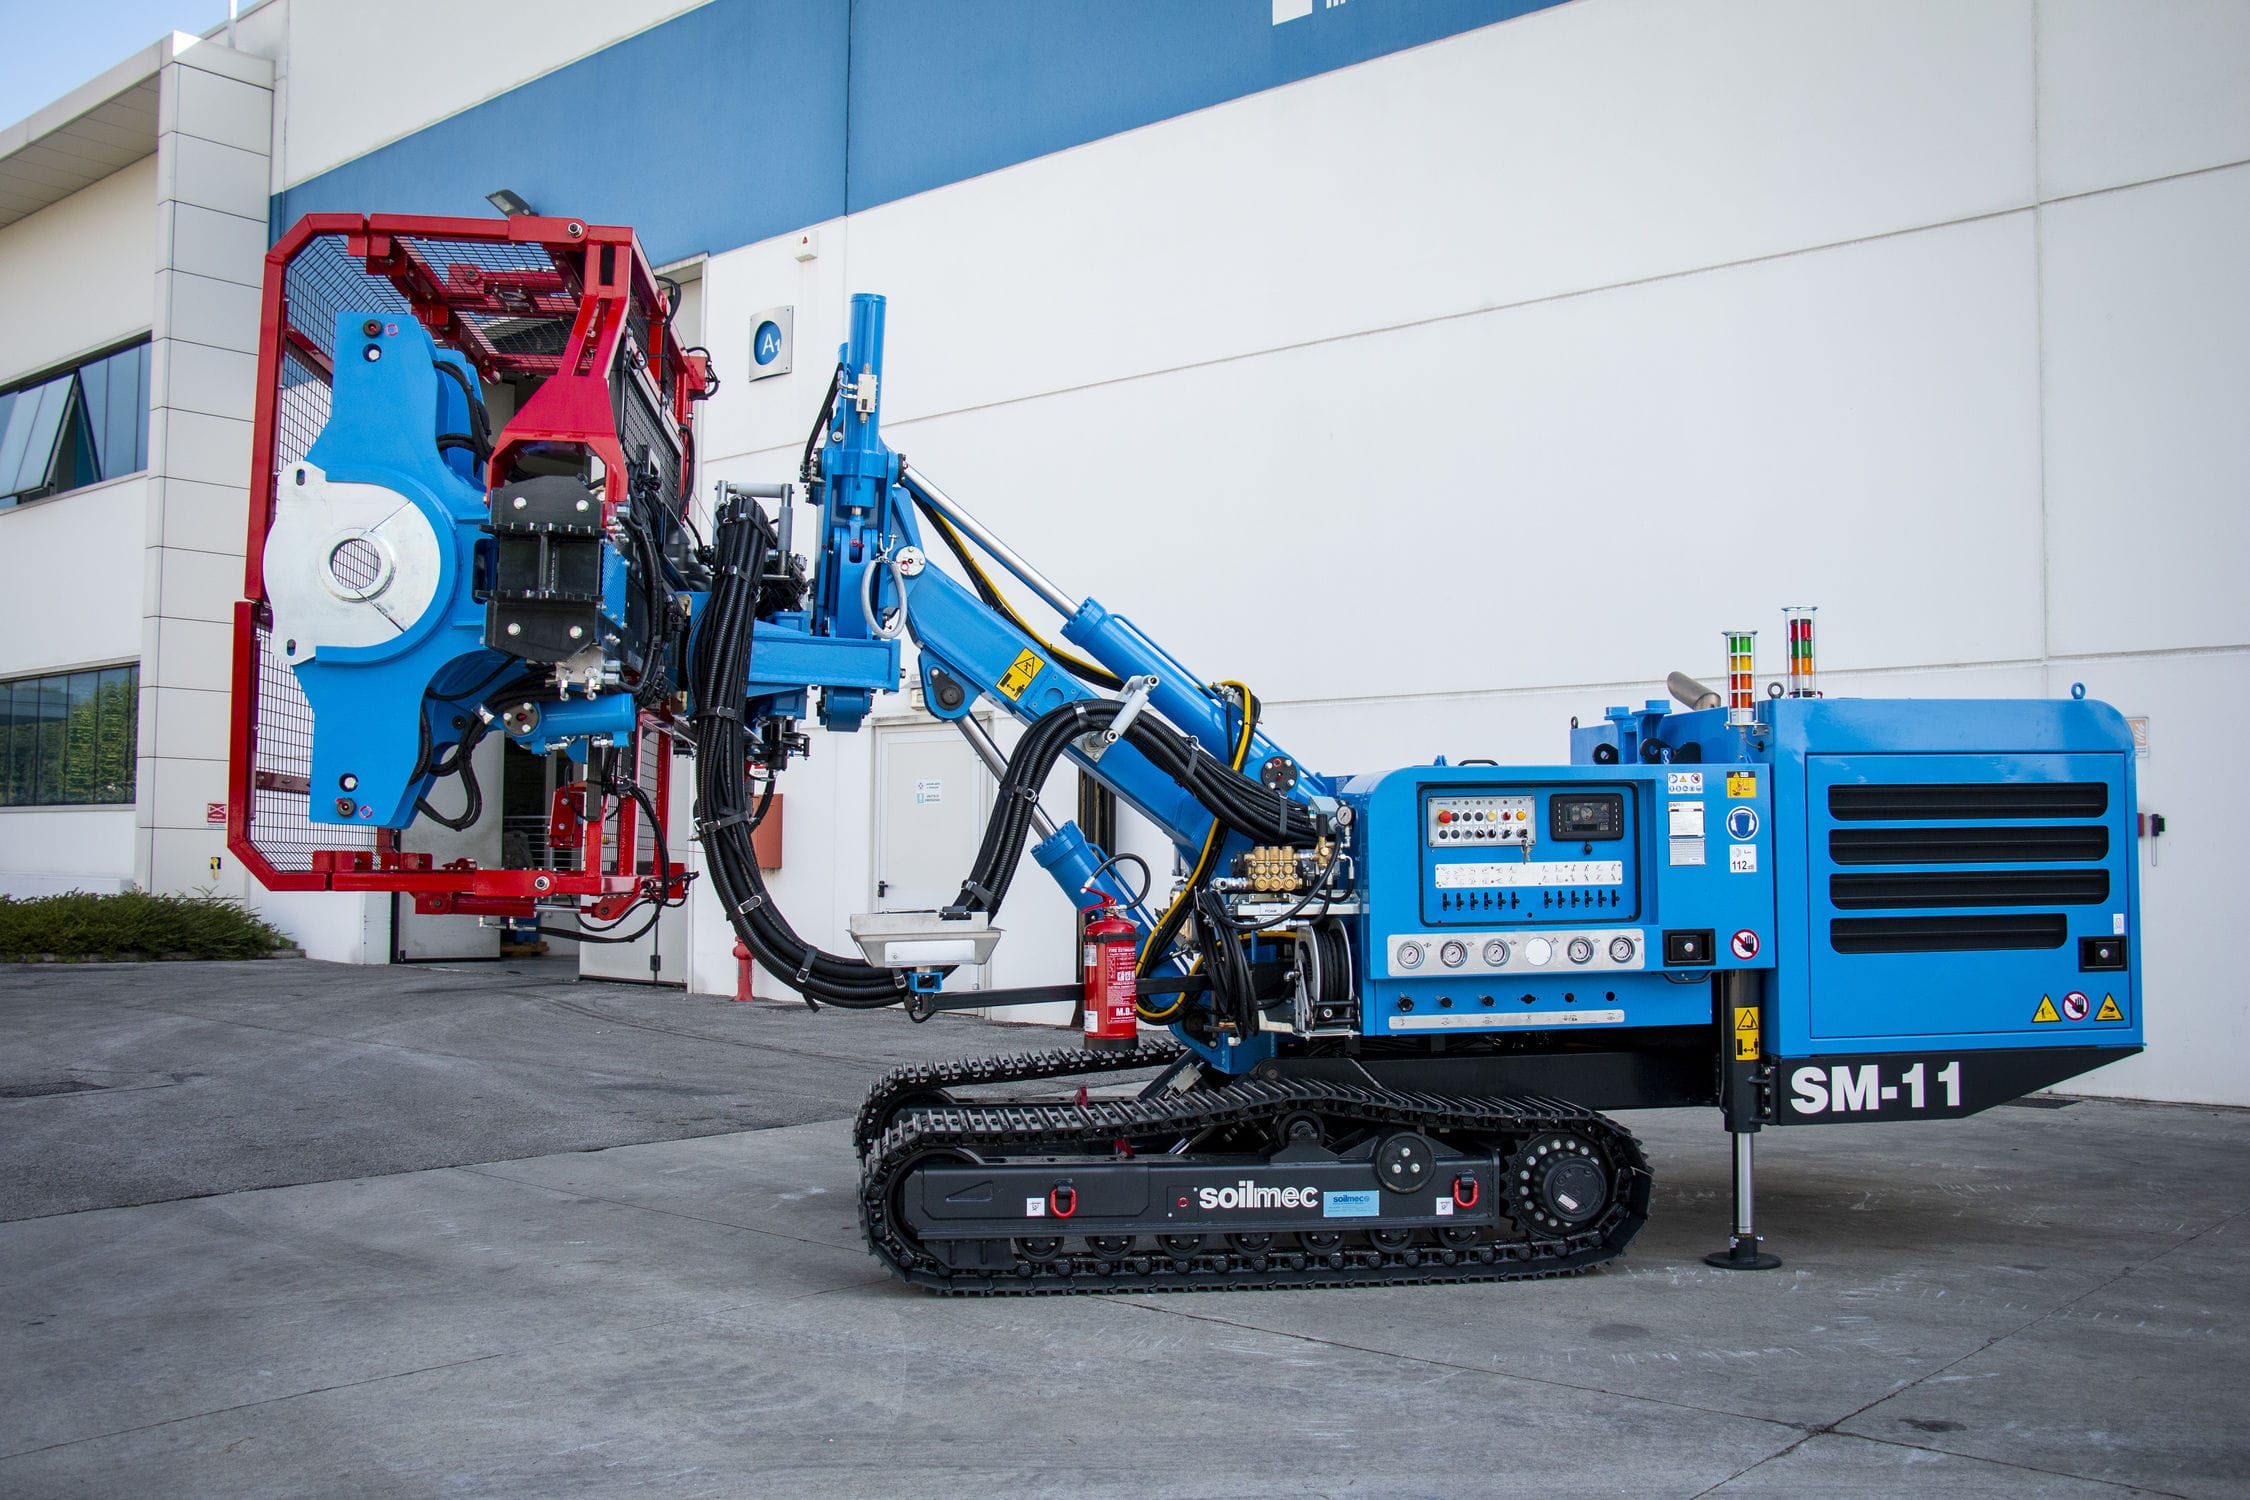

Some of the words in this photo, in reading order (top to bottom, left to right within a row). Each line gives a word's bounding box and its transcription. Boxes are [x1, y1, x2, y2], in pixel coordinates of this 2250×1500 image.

[761, 332, 781, 355] A1
[1732, 860, 1747, 870] 112
[1790, 1061, 1961, 1115] SM-11
[1199, 1180, 1319, 1209] soilmec
[1333, 1194, 1364, 1203] soilmec
